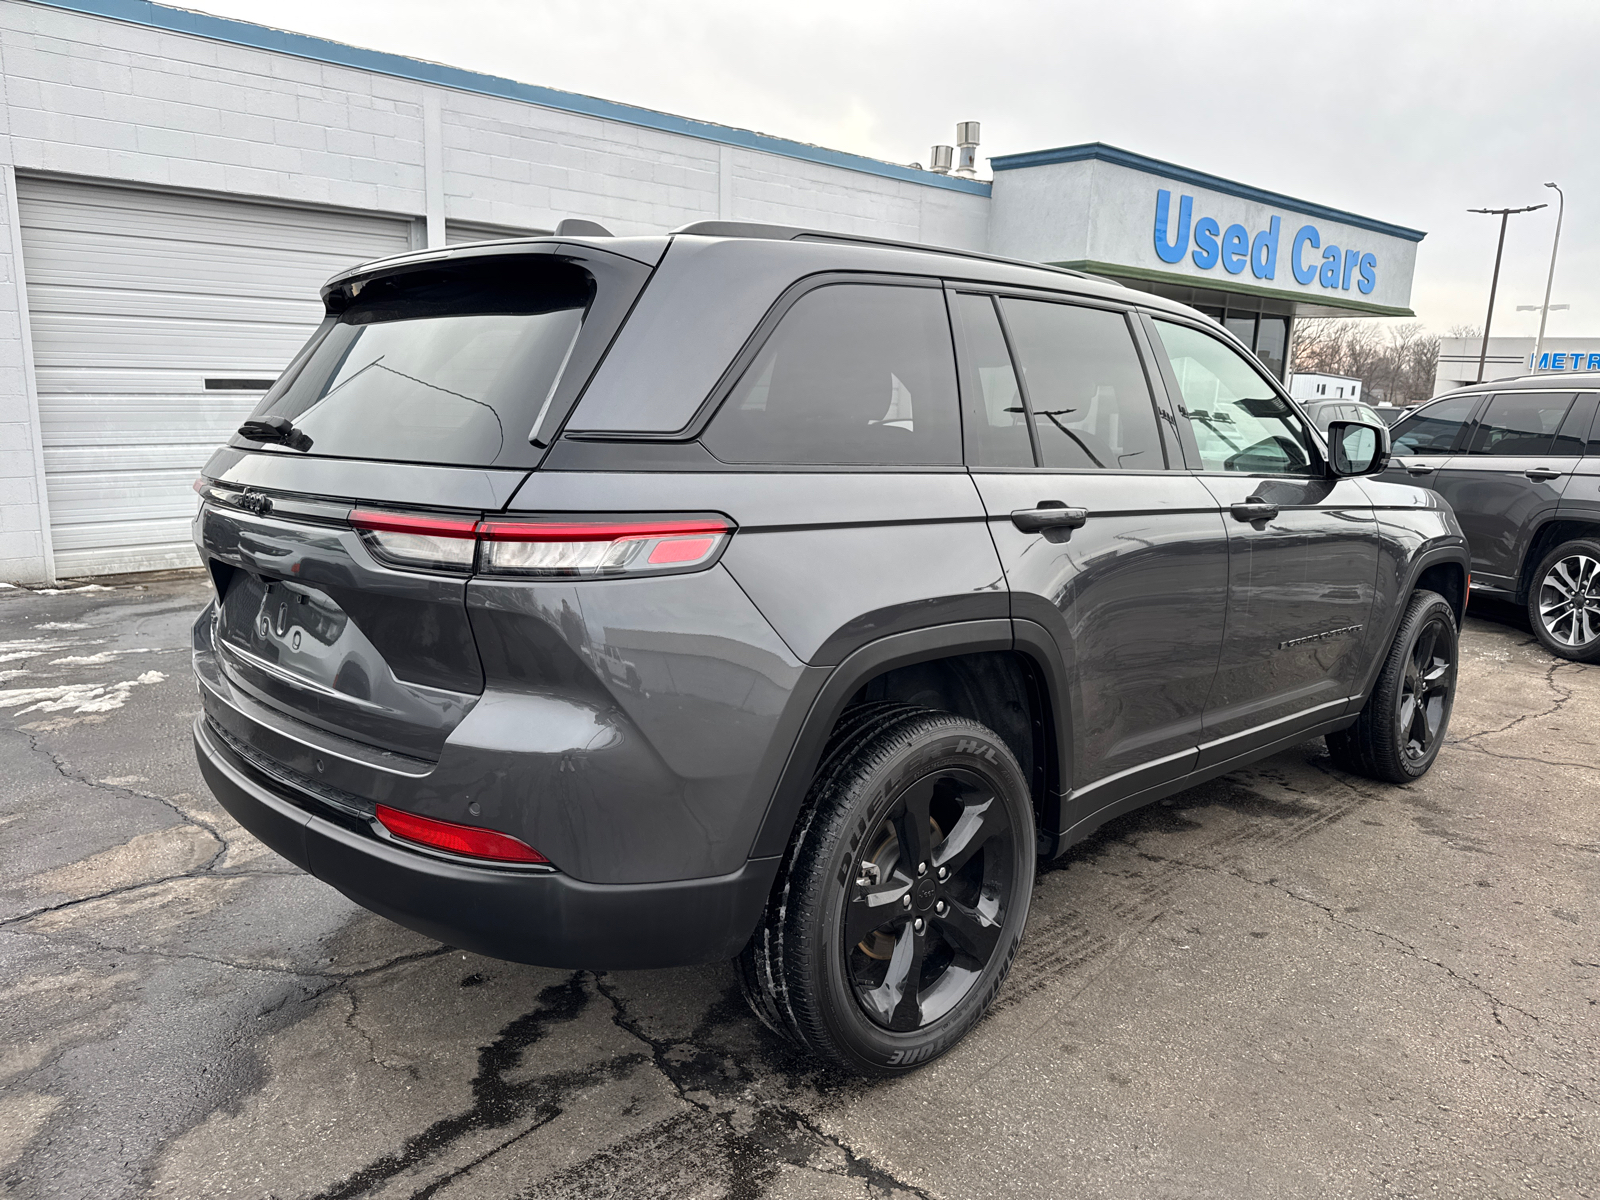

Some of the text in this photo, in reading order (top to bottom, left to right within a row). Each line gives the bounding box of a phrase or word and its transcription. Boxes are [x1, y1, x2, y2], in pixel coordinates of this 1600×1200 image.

[1153, 188, 1377, 294] Used Cars
[837, 739, 999, 889] DUELER H/L
[886, 933, 1019, 1066] BRIDGESTONE
